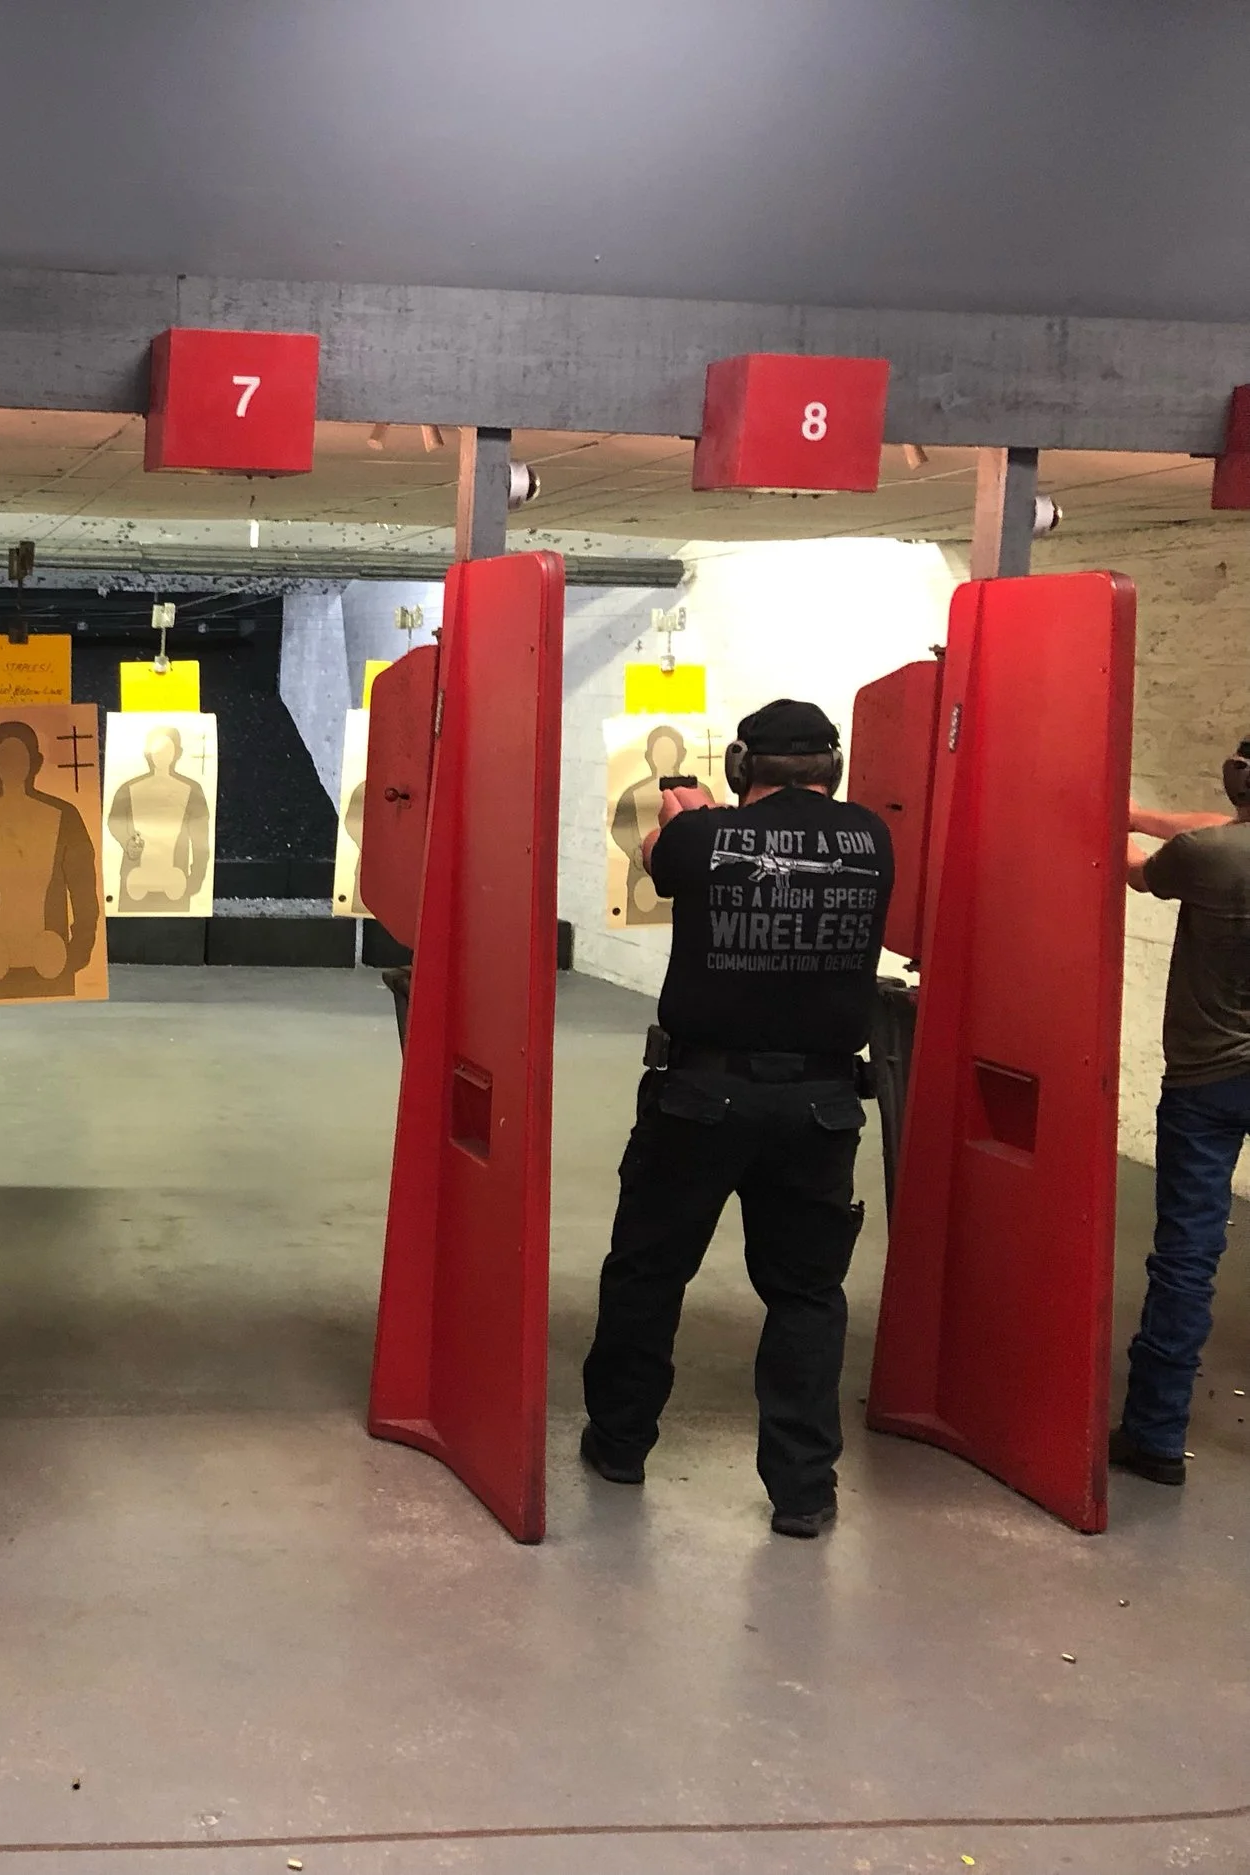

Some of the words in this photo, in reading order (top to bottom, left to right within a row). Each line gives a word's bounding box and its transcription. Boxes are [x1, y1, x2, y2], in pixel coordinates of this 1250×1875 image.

[232, 375, 261, 418] 7
[801, 401, 828, 441] 8
[713, 828, 756, 851] IT'S
[765, 829, 806, 853] NOT
[817, 831, 830, 854] A
[836, 831, 877, 854] GUN
[709, 884, 743, 906] IT'S
[751, 886, 763, 908] A
[770, 887, 814, 909] HIGH
[823, 888, 877, 909] SPEED
[710, 910, 873, 950] WIRELESS
[707, 952, 819, 972] COMMUNICATION
[824, 954, 866, 972] DEVICE
